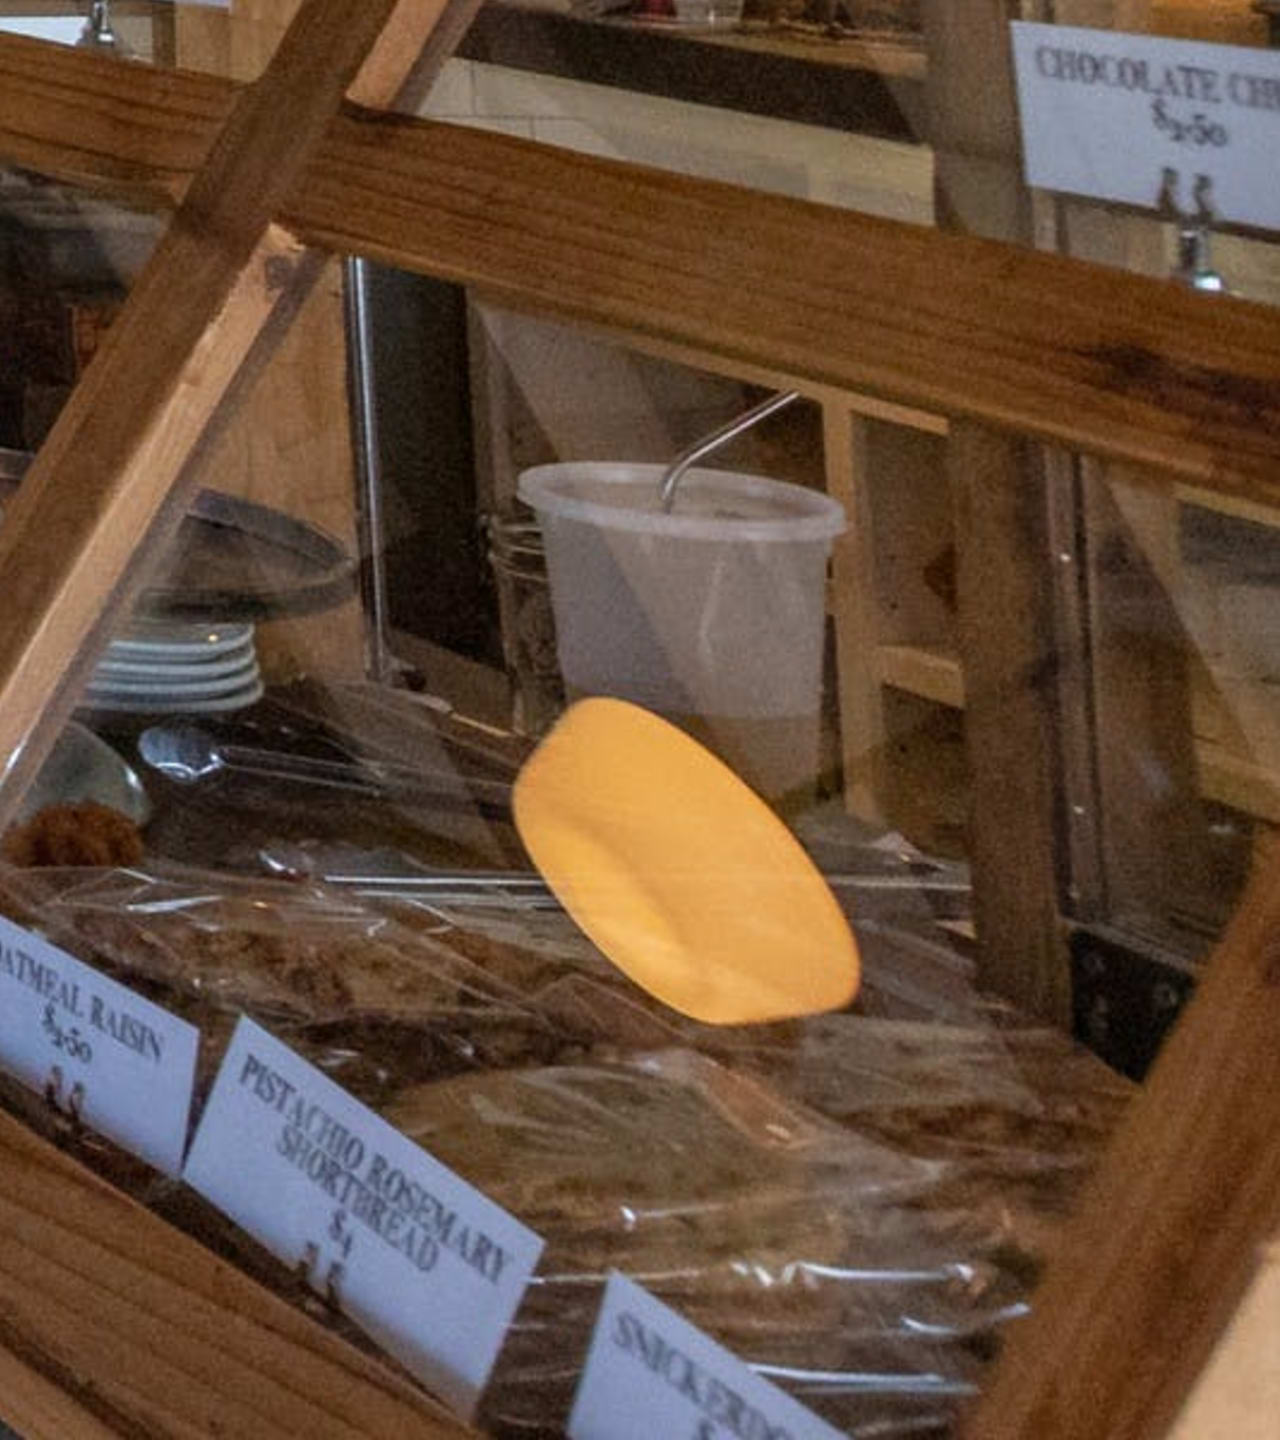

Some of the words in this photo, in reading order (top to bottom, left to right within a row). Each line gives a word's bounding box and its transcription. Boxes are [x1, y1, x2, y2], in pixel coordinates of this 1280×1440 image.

[1035, 46, 1222, 104] CHOCOLATE
[90, 993, 163, 1064] RAISIN
[241, 1053, 364, 1173] PISTACHIO
[367, 1153, 510, 1285] ROSEMARY
[276, 1123, 439, 1273] SHORTBREAD
